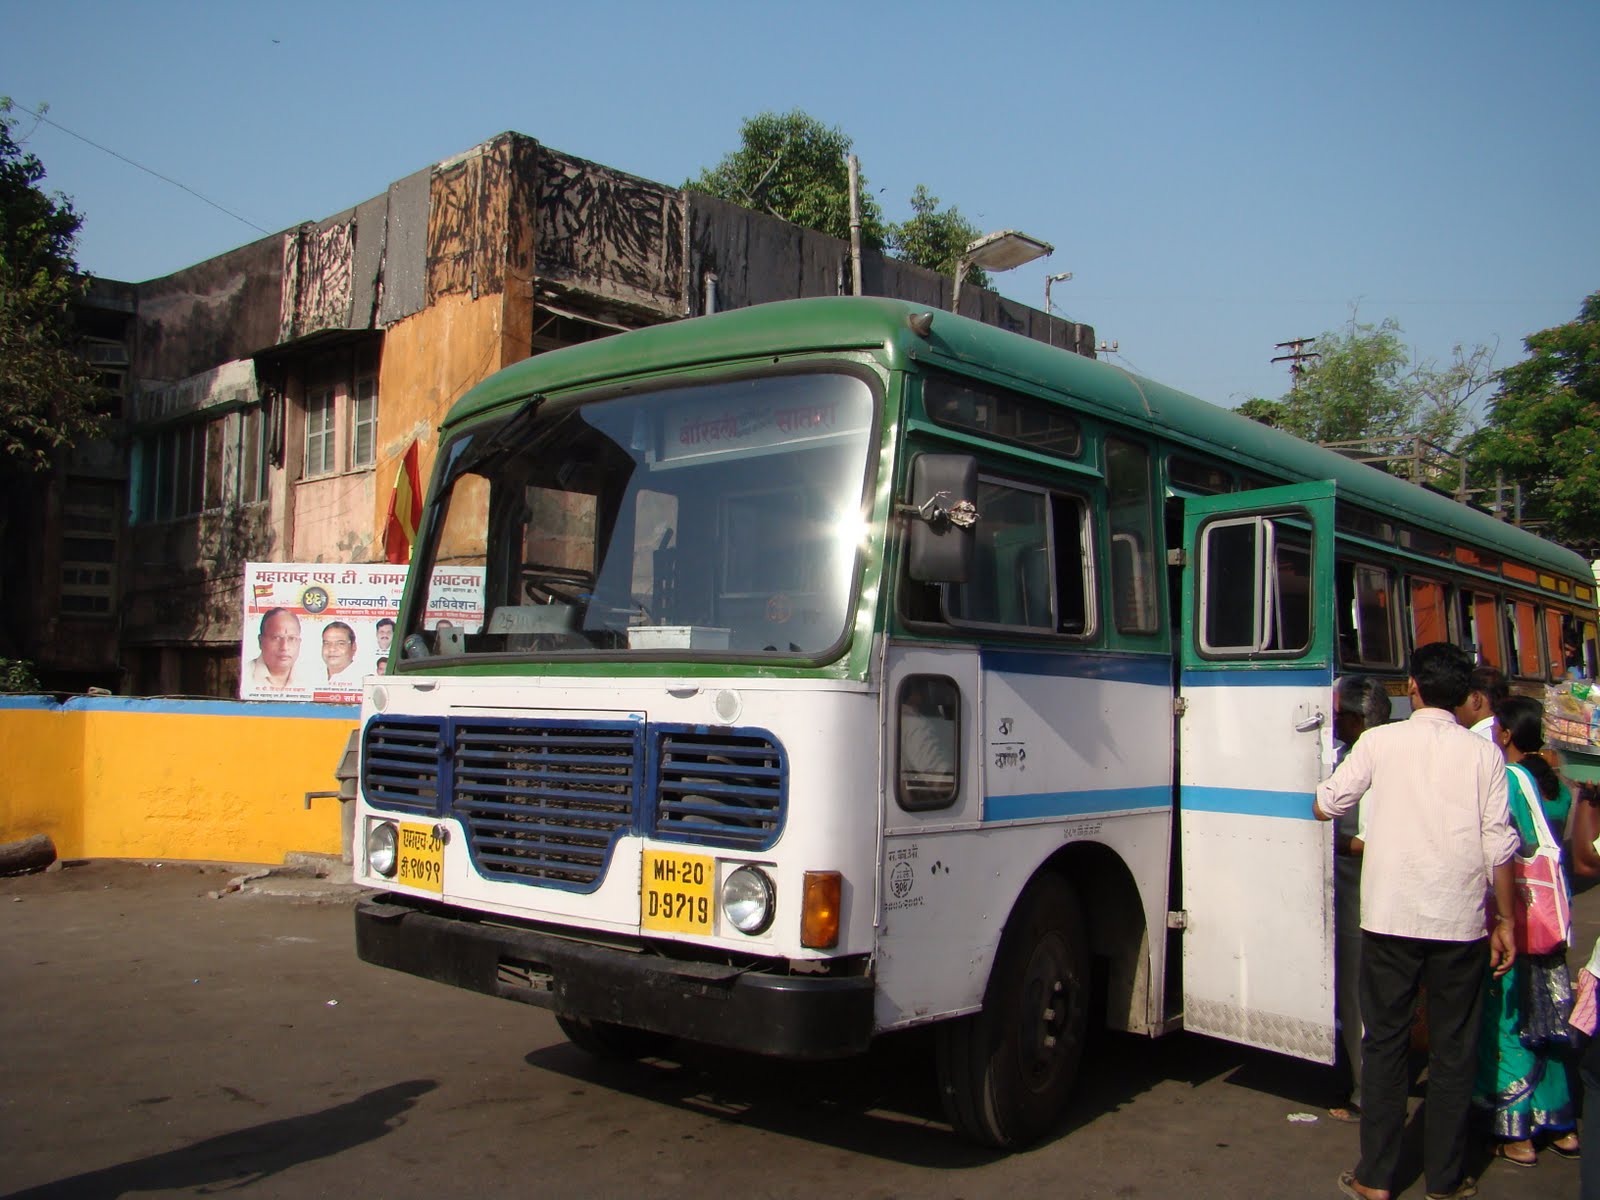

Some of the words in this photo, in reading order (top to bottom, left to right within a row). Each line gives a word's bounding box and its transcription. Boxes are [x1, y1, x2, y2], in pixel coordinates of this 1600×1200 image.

[255, 571, 310, 586] महाराष्ट्र
[432, 569, 482, 587] संघटना
[337, 595, 388, 608] राज्यव्यापी
[429, 596, 477, 611] अधिवेशन
